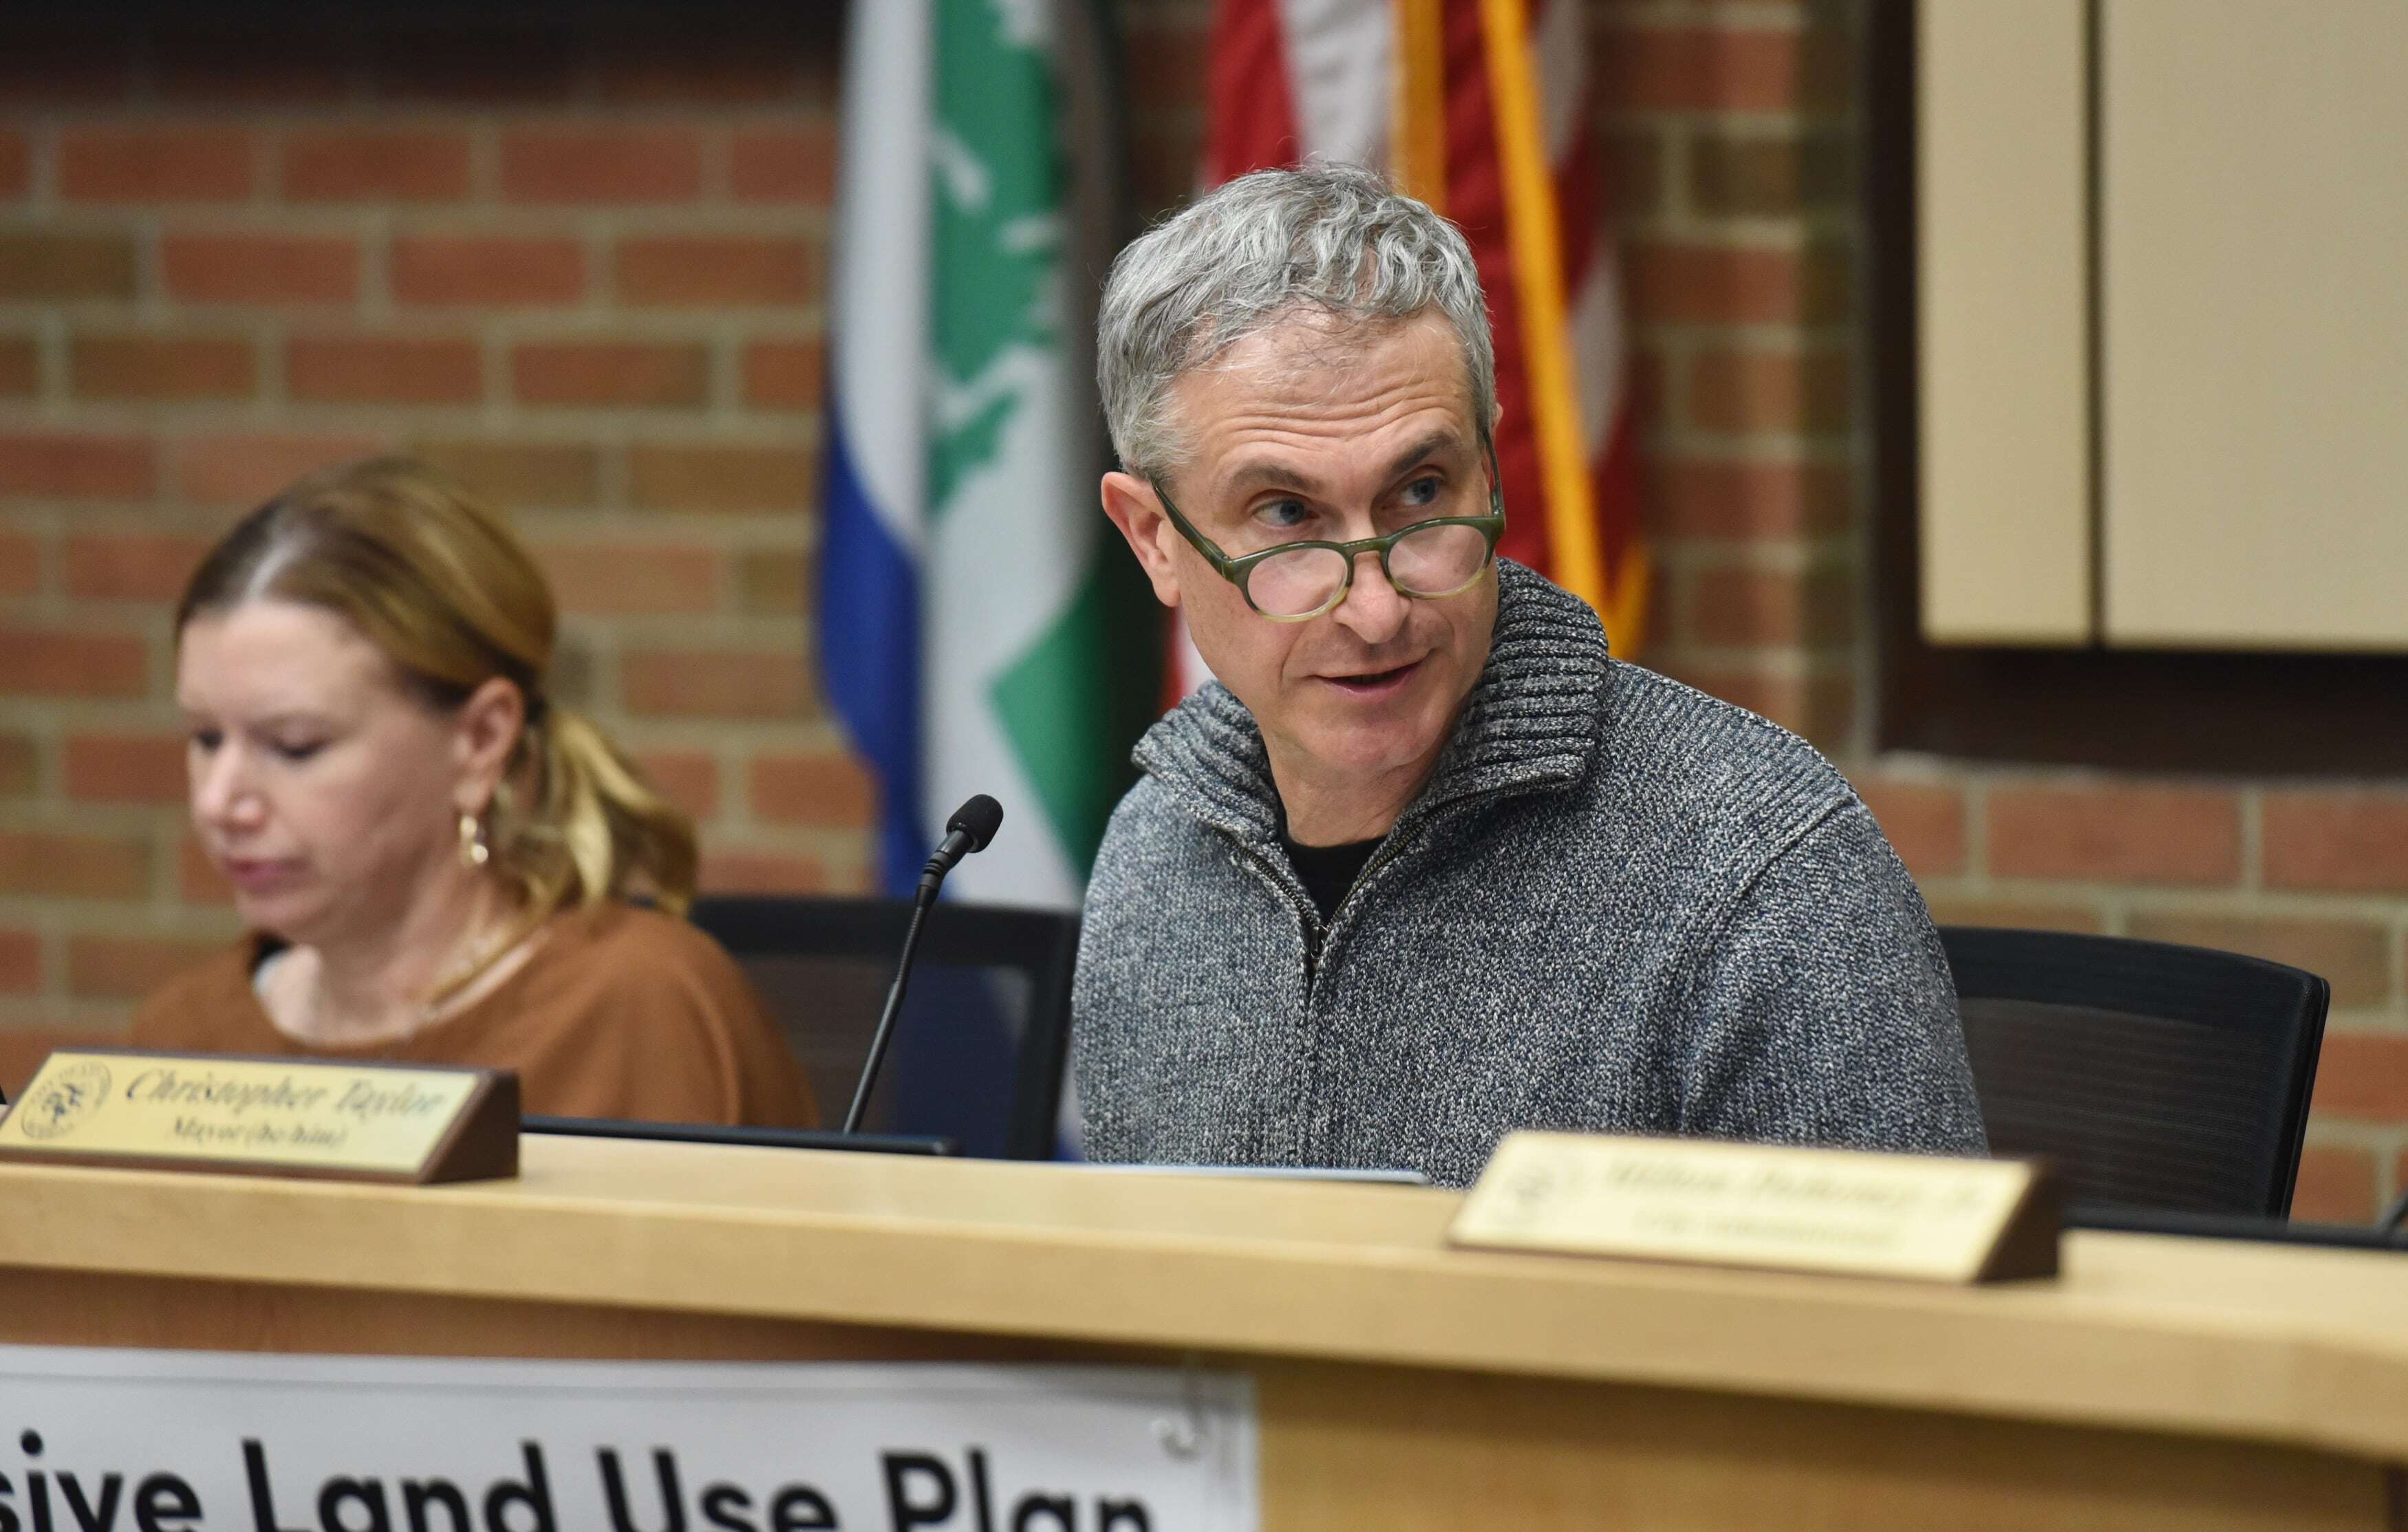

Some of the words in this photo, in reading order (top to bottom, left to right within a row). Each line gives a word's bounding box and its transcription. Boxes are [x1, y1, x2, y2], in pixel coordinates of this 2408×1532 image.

[241, 1437, 559, 1532] Land
[595, 1446, 839, 1532] Use
[880, 1447, 1152, 1532] Plan
